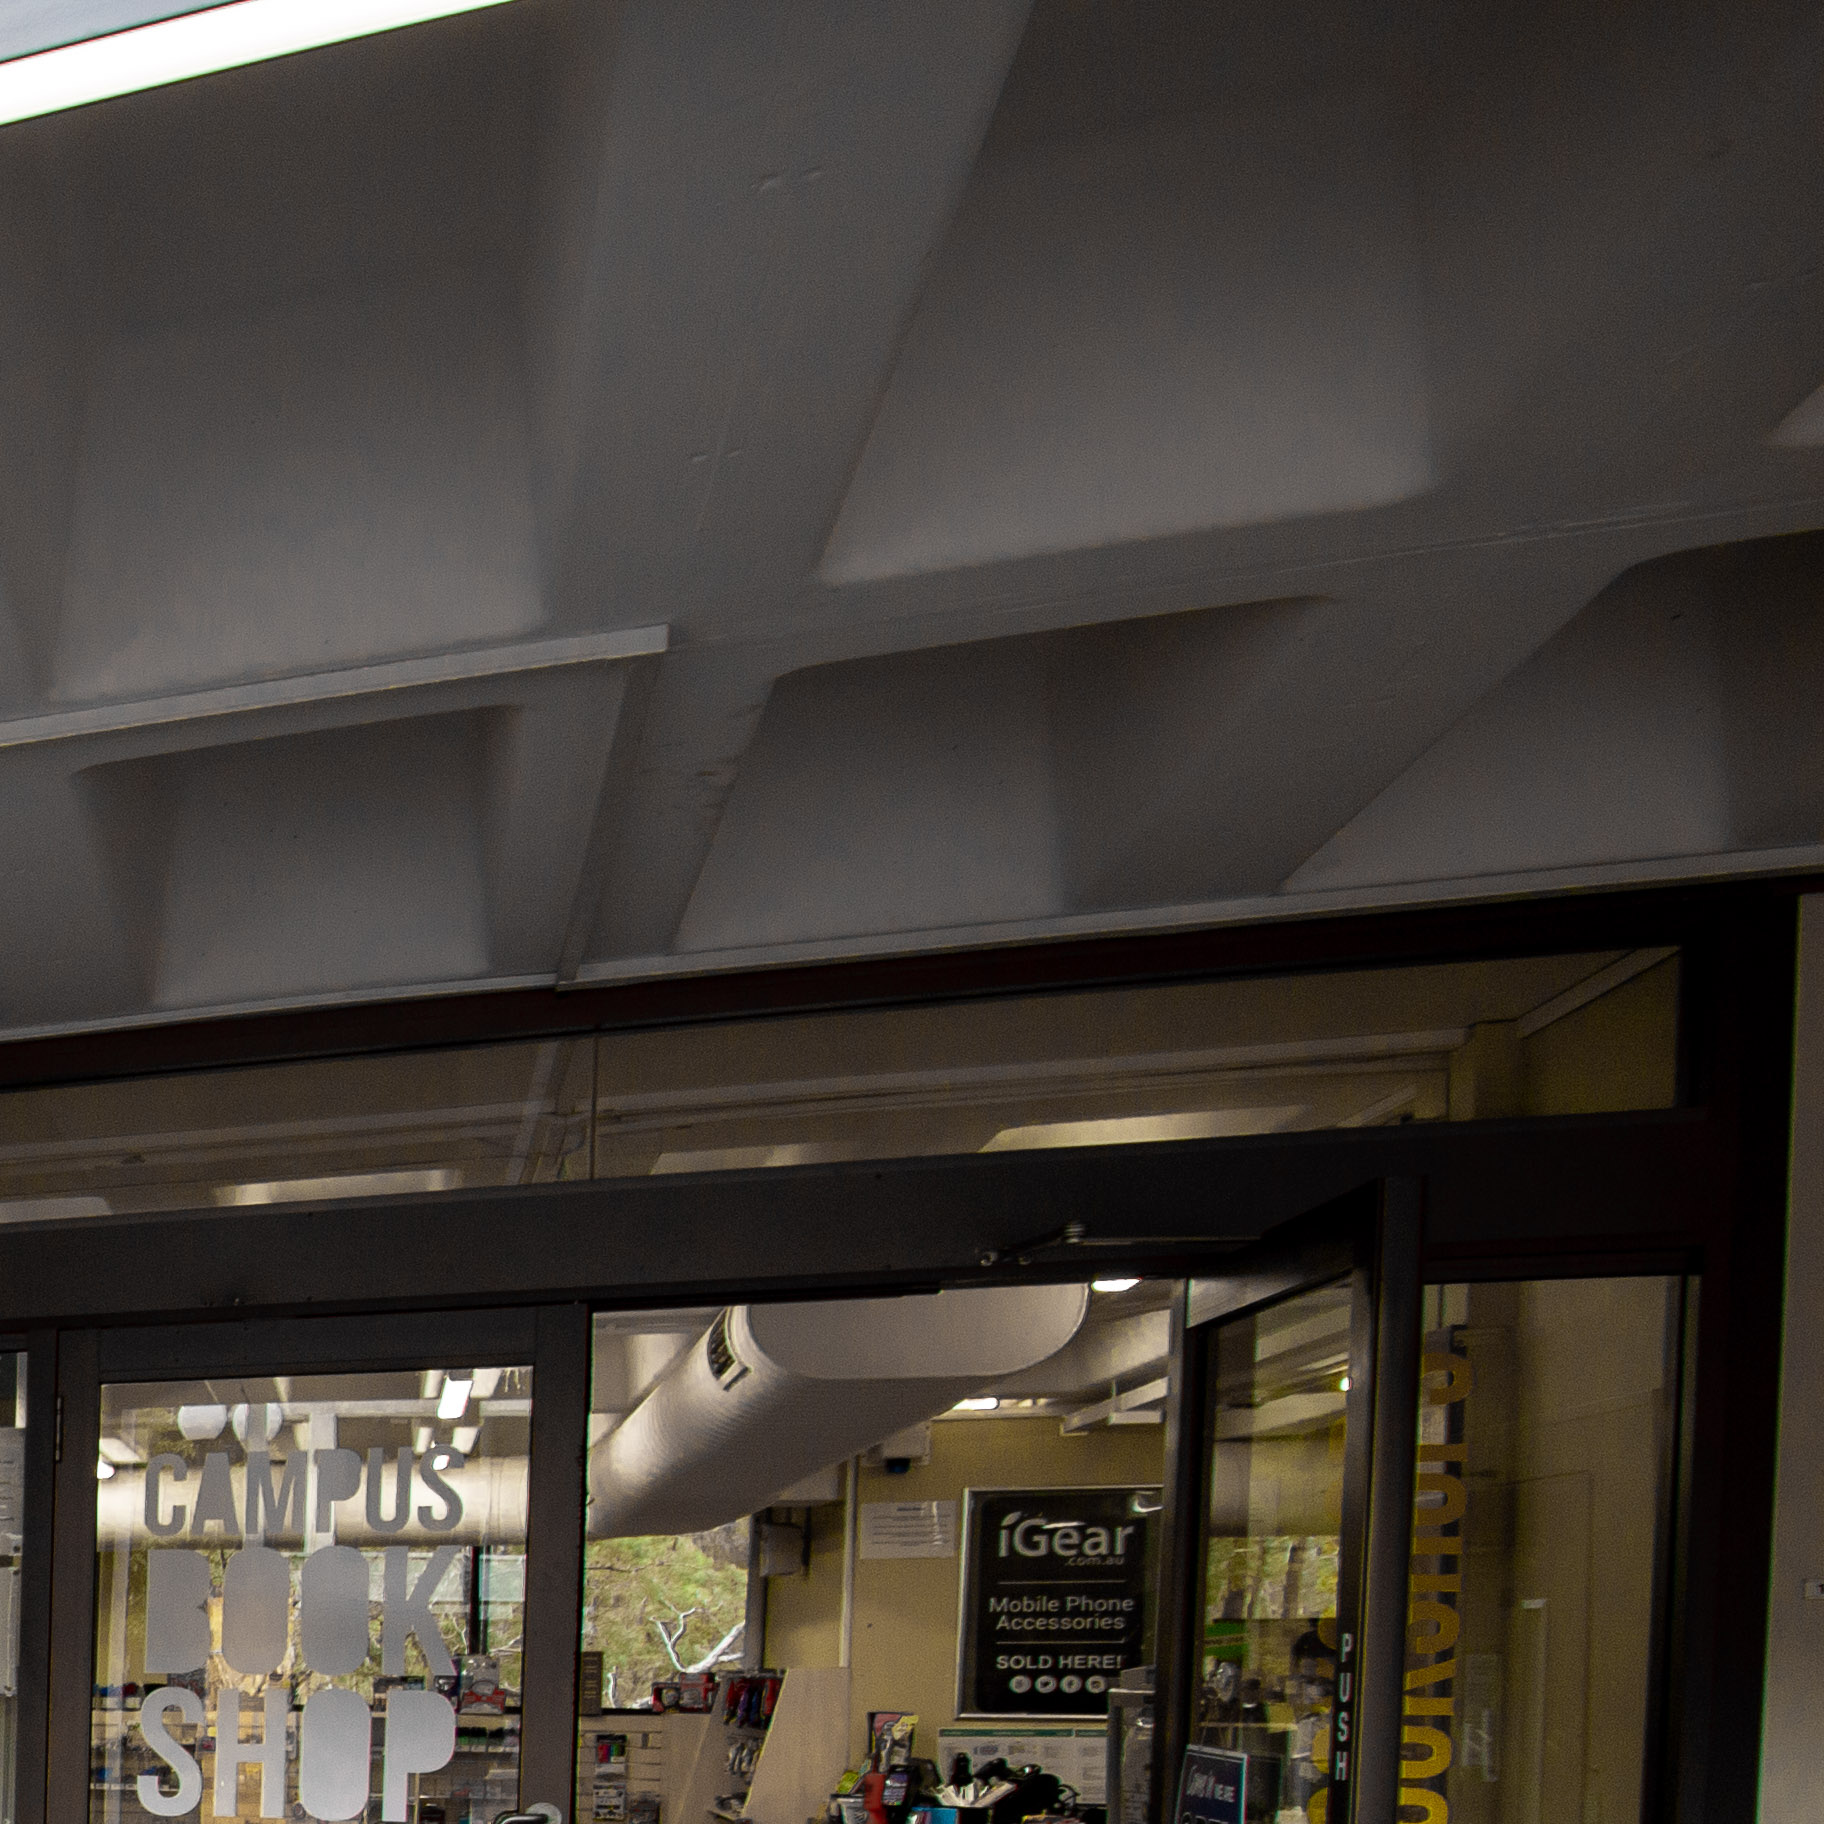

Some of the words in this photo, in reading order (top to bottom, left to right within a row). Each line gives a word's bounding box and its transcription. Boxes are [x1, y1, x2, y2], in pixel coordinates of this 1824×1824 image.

[144, 1444, 466, 1537] CAMPUS
[998, 1511, 1136, 1558] iGear
[144, 1544, 461, 1677] BOOK
[989, 1595, 1060, 1613] Mobile
[1066, 1595, 1135, 1612] Phone
[996, 1613, 1126, 1631] Accessories
[996, 1655, 1053, 1670] SOLD
[1059, 1655, 1123, 1669] HERE!
[136, 1685, 458, 1824] SHOP
